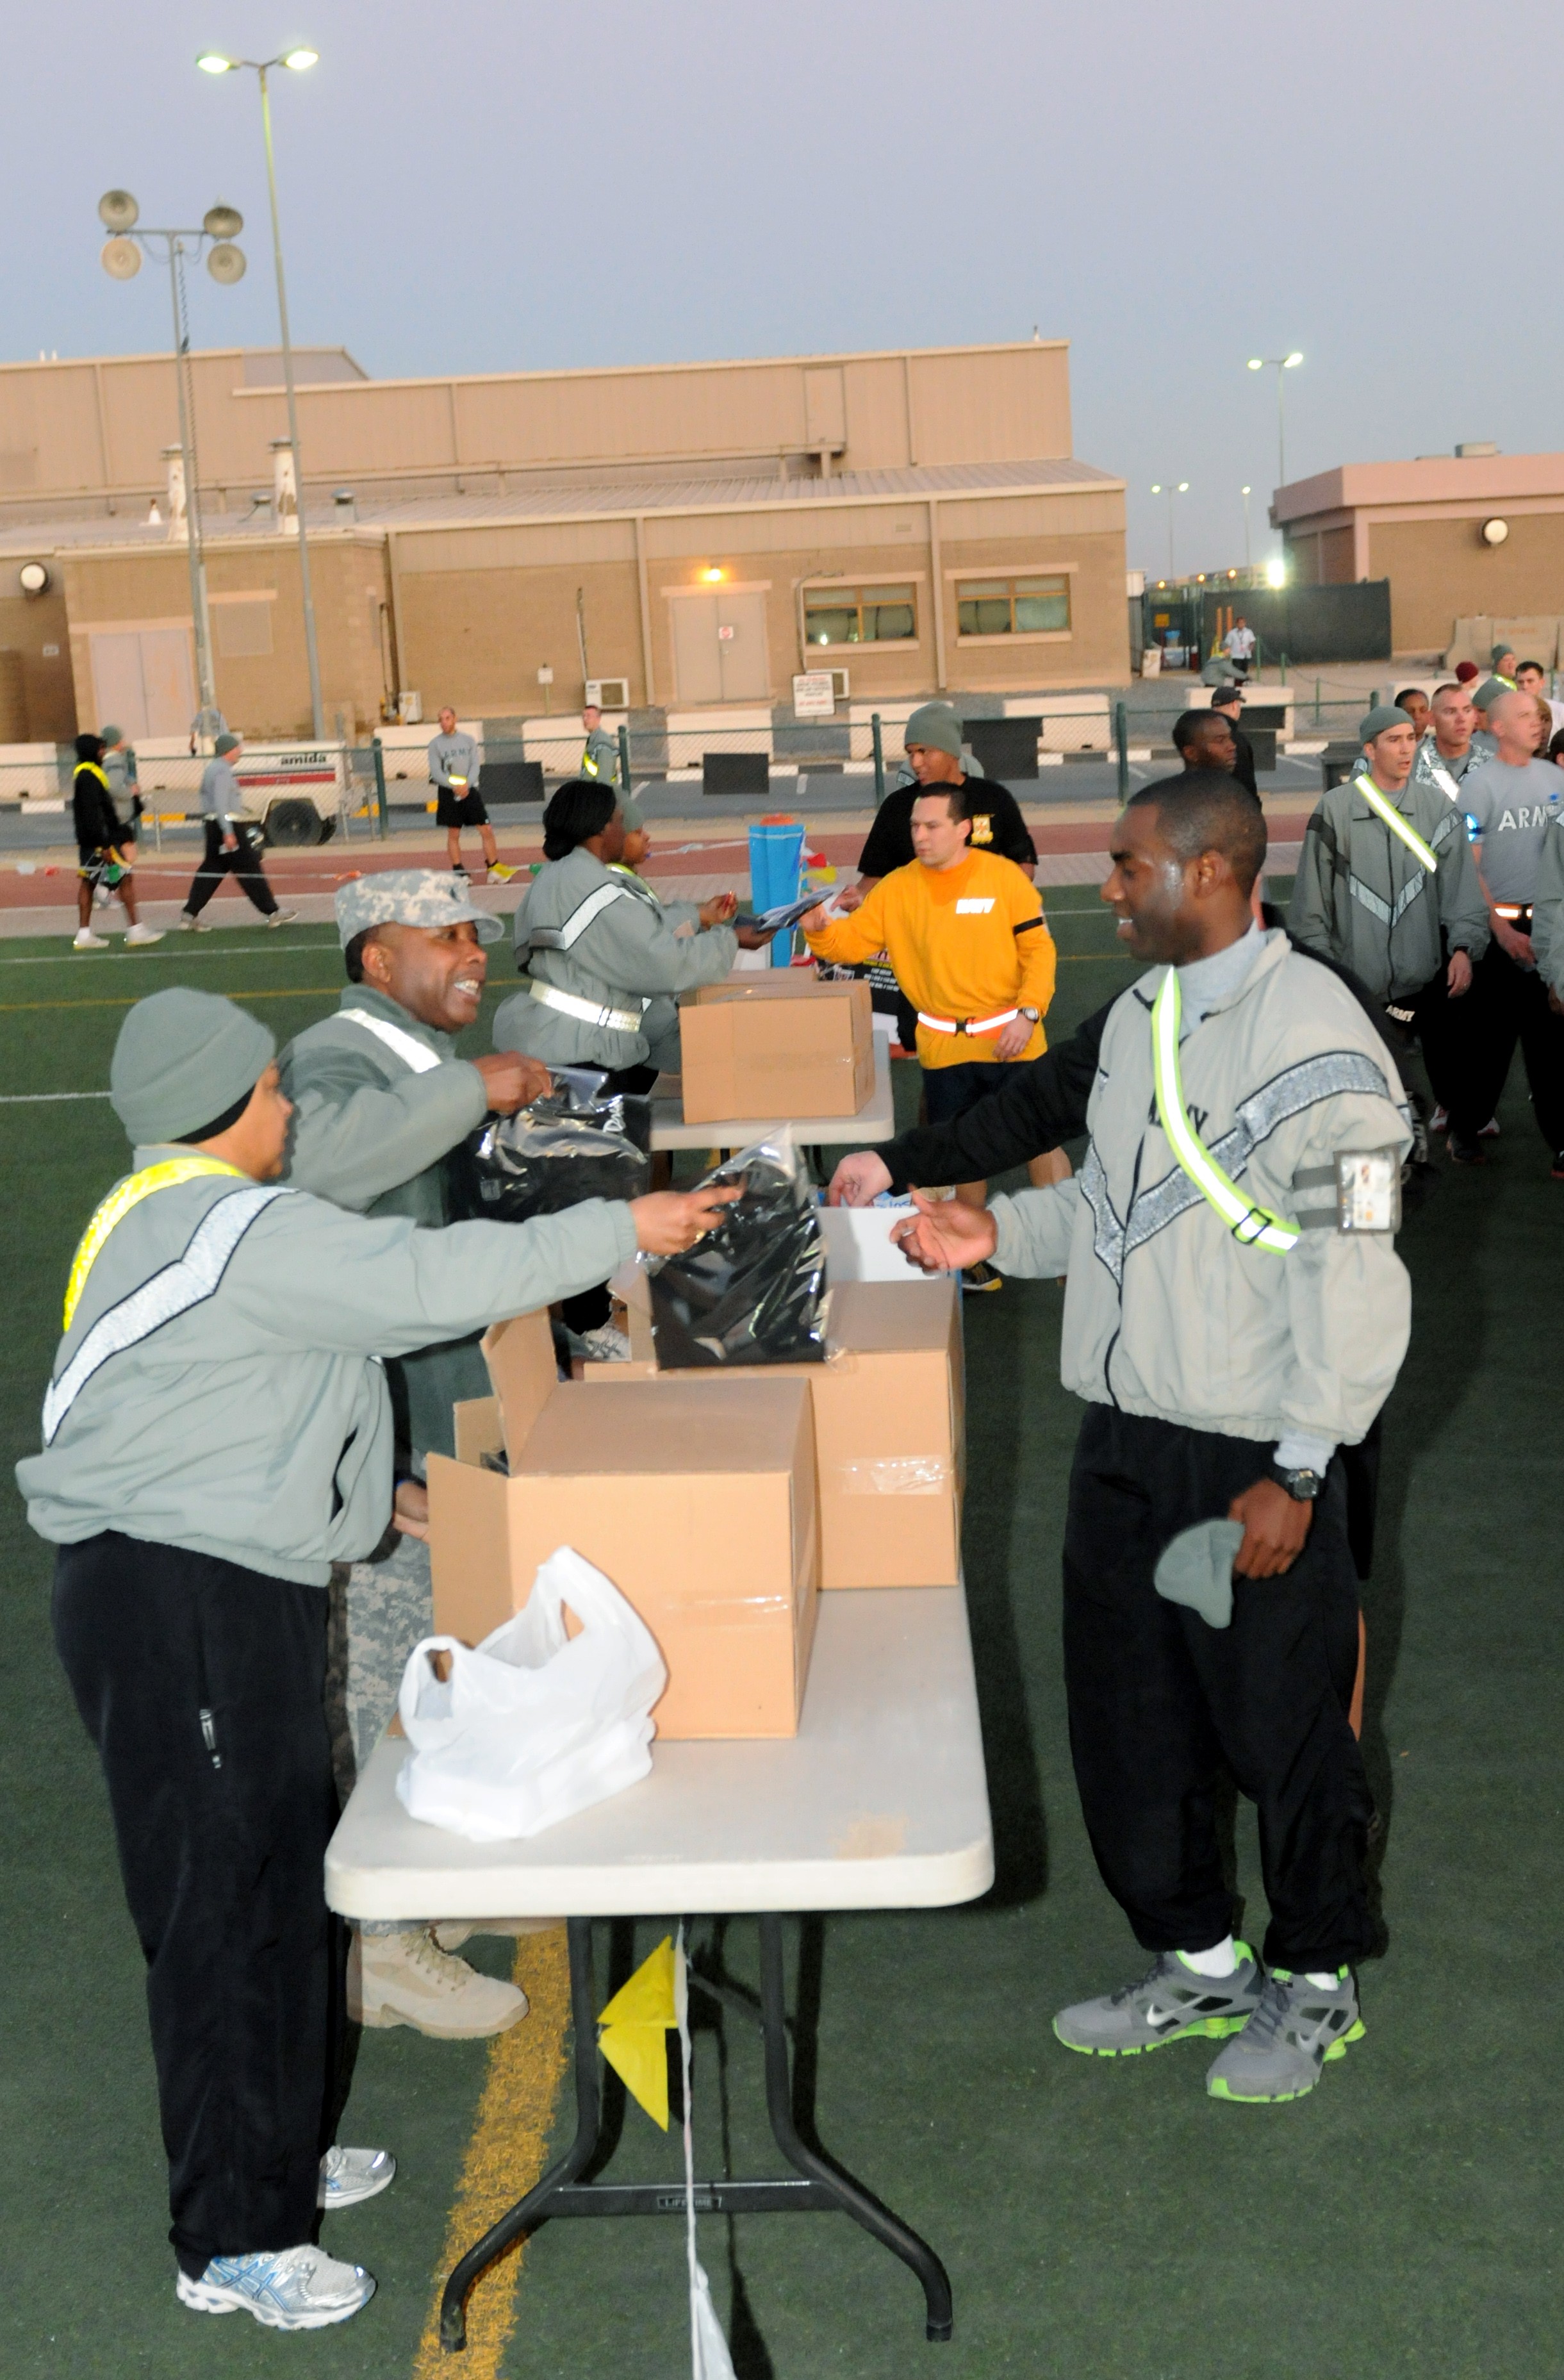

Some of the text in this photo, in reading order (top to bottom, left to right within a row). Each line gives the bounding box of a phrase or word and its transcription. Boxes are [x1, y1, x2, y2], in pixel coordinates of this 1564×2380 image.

[281, 752, 326, 765] amida
[1497, 806, 1547, 831] ARM
[1385, 1004, 1415, 1022] ARMY
[665, 2199, 712, 2207] LIFEIME
